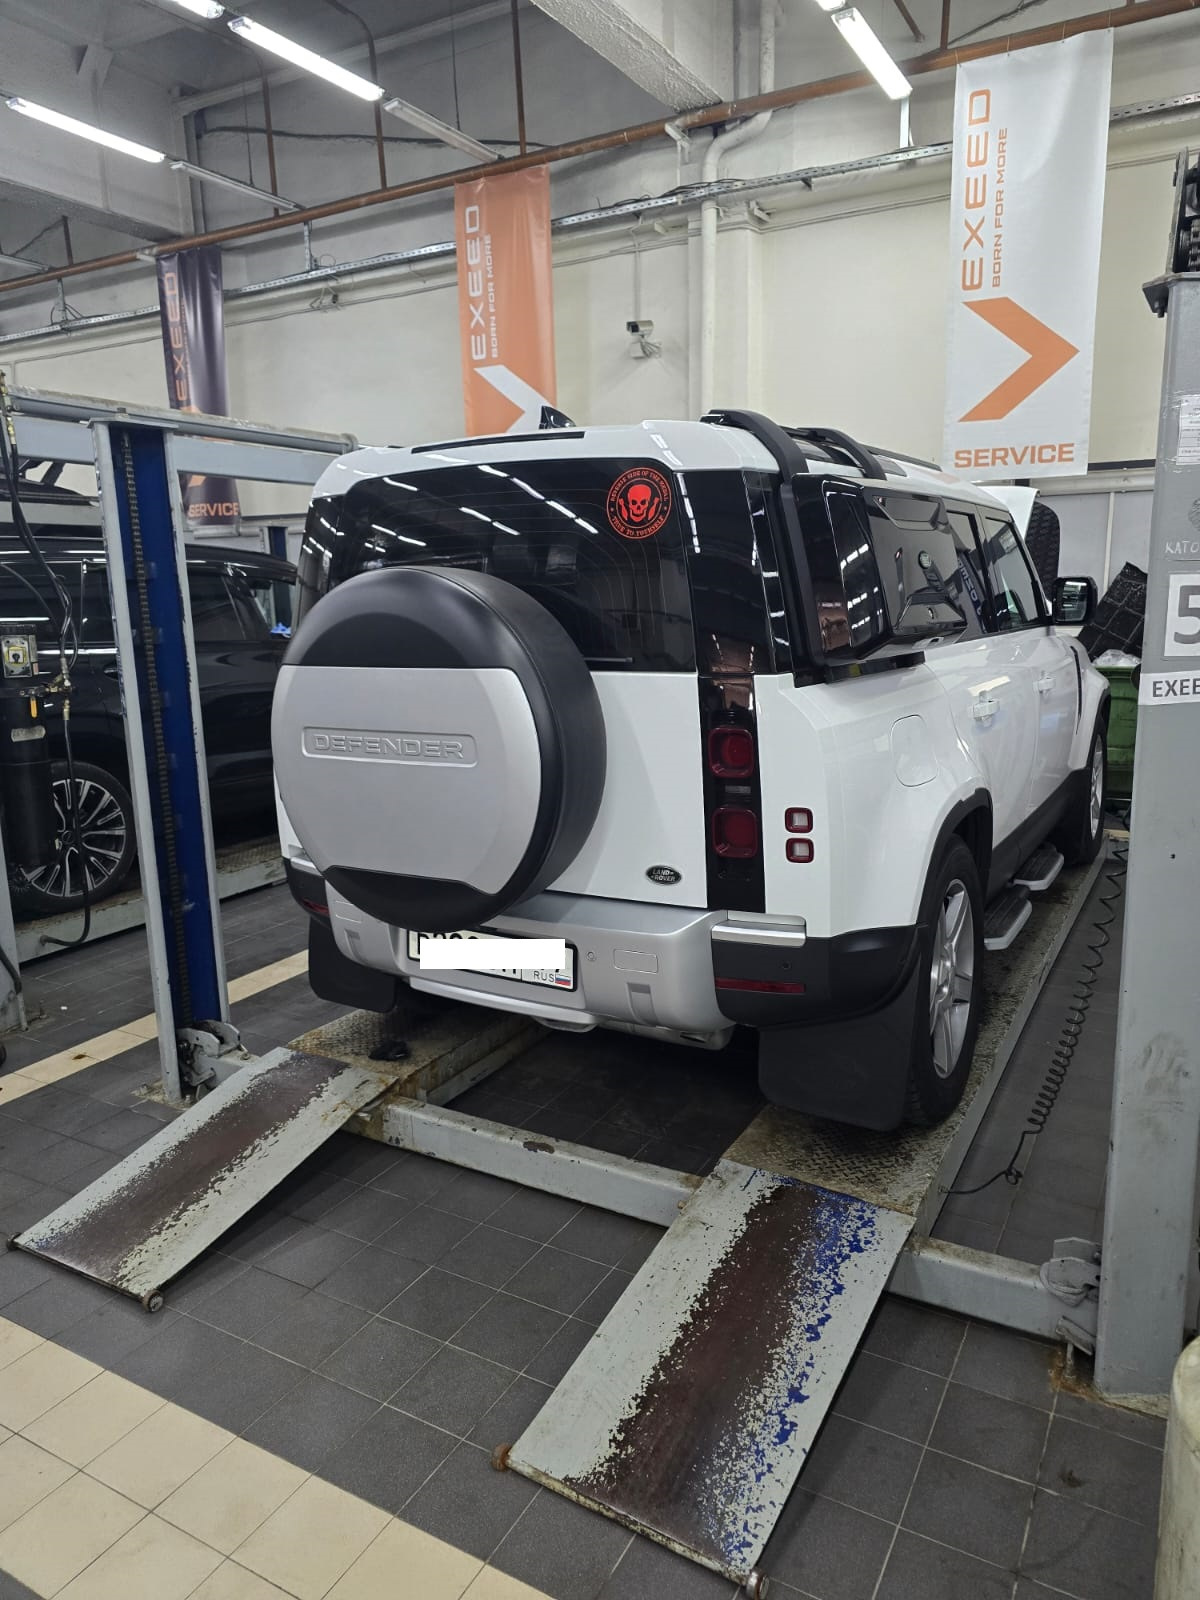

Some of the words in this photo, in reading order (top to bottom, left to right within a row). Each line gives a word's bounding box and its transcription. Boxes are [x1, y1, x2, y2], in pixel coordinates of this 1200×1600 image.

[996, 127, 1008, 184] MORE
[961, 88, 992, 291] EXEED
[994, 189, 1005, 229] FOR
[484, 234, 493, 279] MORE
[992, 234, 1003, 288] BORN
[464, 205, 487, 361] EXEED
[486, 281, 496, 313] FOR
[164, 272, 188, 401] EXEED
[487, 315, 498, 358] BORN
[954, 443, 1075, 468] SERVICE
[188, 502, 240, 518] SERVICE
[1174, 585, 1200, 645] 5
[313, 734, 464, 760] DEFENDER
[533, 970, 555, 983] RUS
